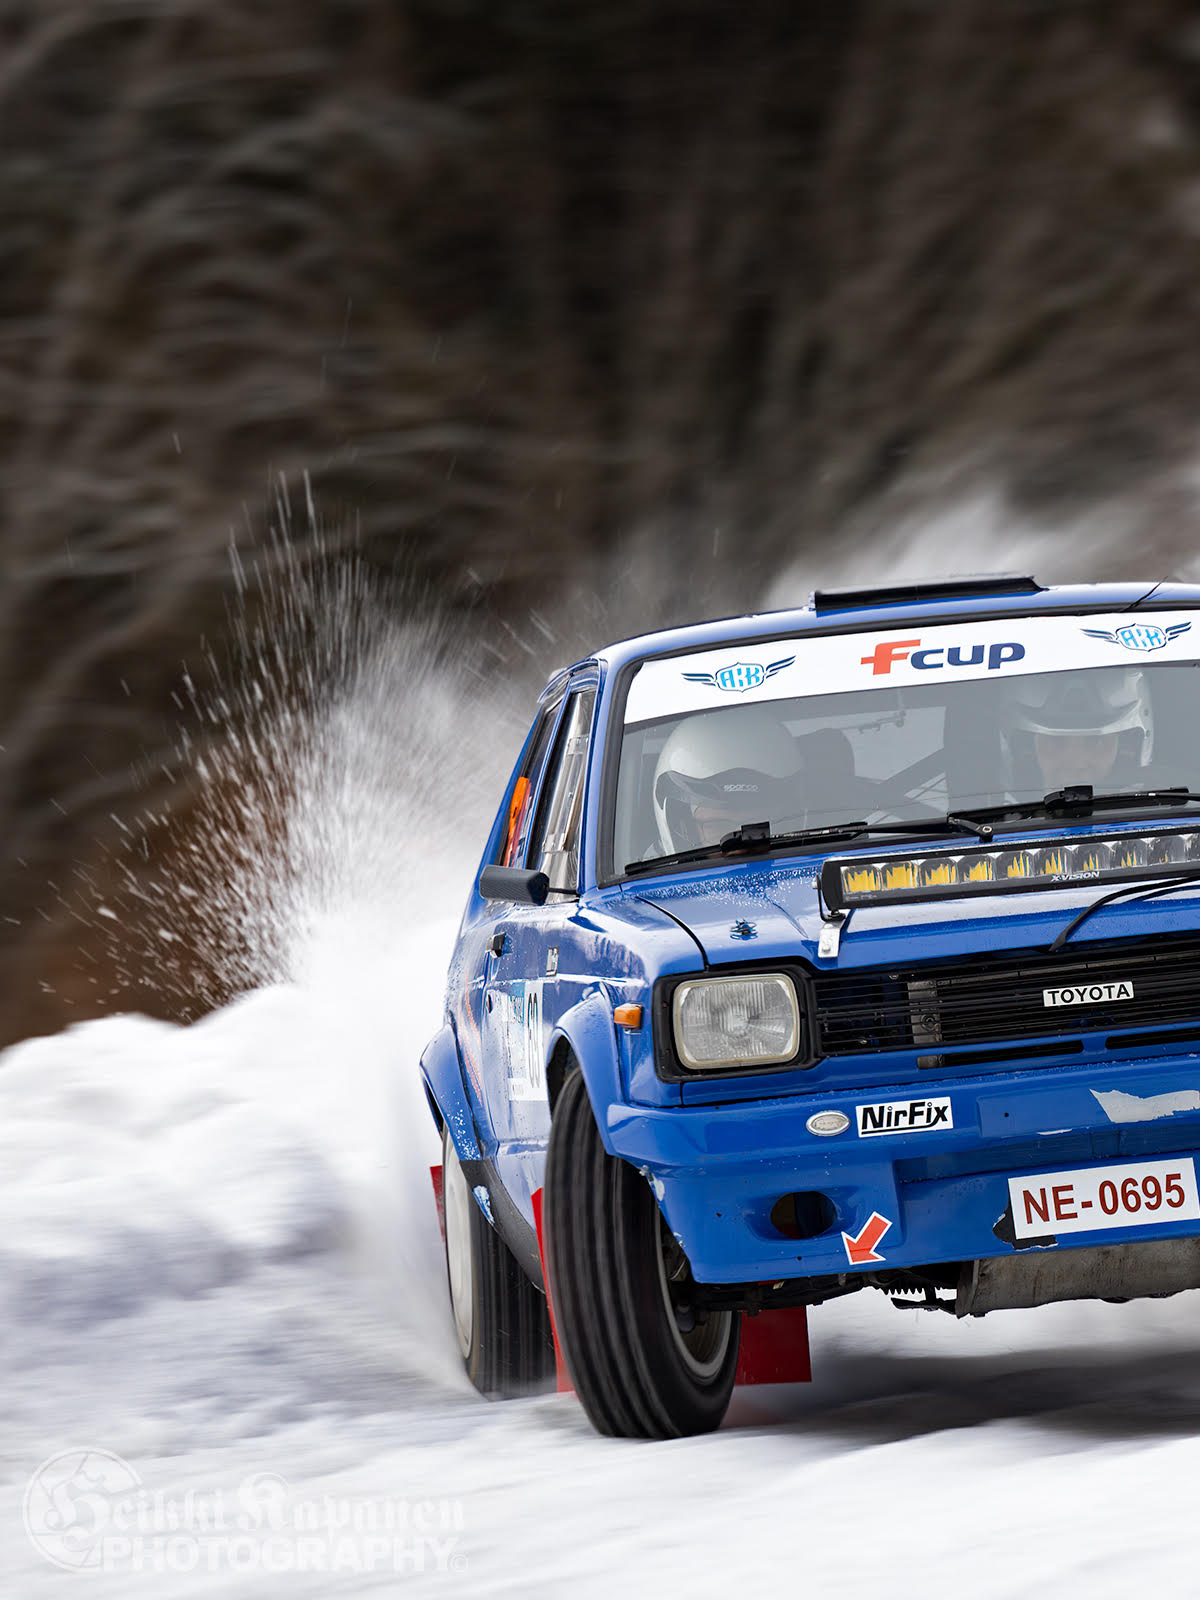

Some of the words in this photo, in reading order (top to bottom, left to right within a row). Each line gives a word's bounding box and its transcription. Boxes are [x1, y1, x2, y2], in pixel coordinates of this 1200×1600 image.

[1047, 984, 1131, 1004] TOYOTA
[861, 1101, 949, 1134] NirFix
[1022, 1173, 1186, 1224] NE-0695
